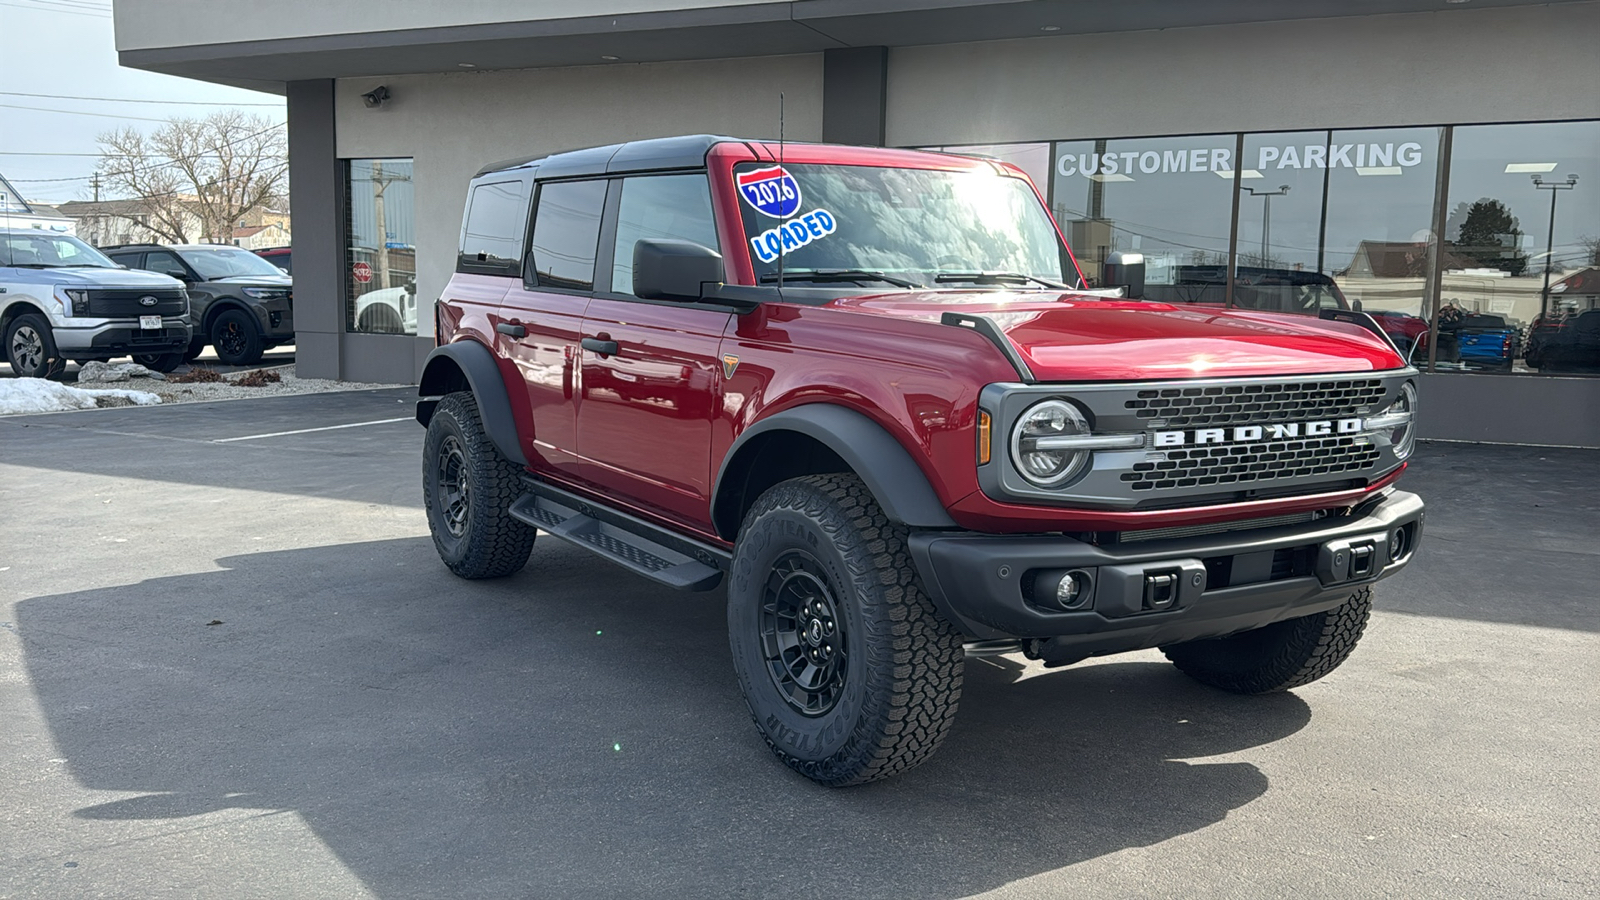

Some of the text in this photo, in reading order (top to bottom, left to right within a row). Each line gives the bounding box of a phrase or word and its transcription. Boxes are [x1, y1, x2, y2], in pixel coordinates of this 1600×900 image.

[1057, 142, 1422, 177] CUSTOMER PARKING
[748, 179, 795, 206] 2026
[753, 211, 833, 261] LOADED
[1154, 418, 1362, 447] BRONCO
